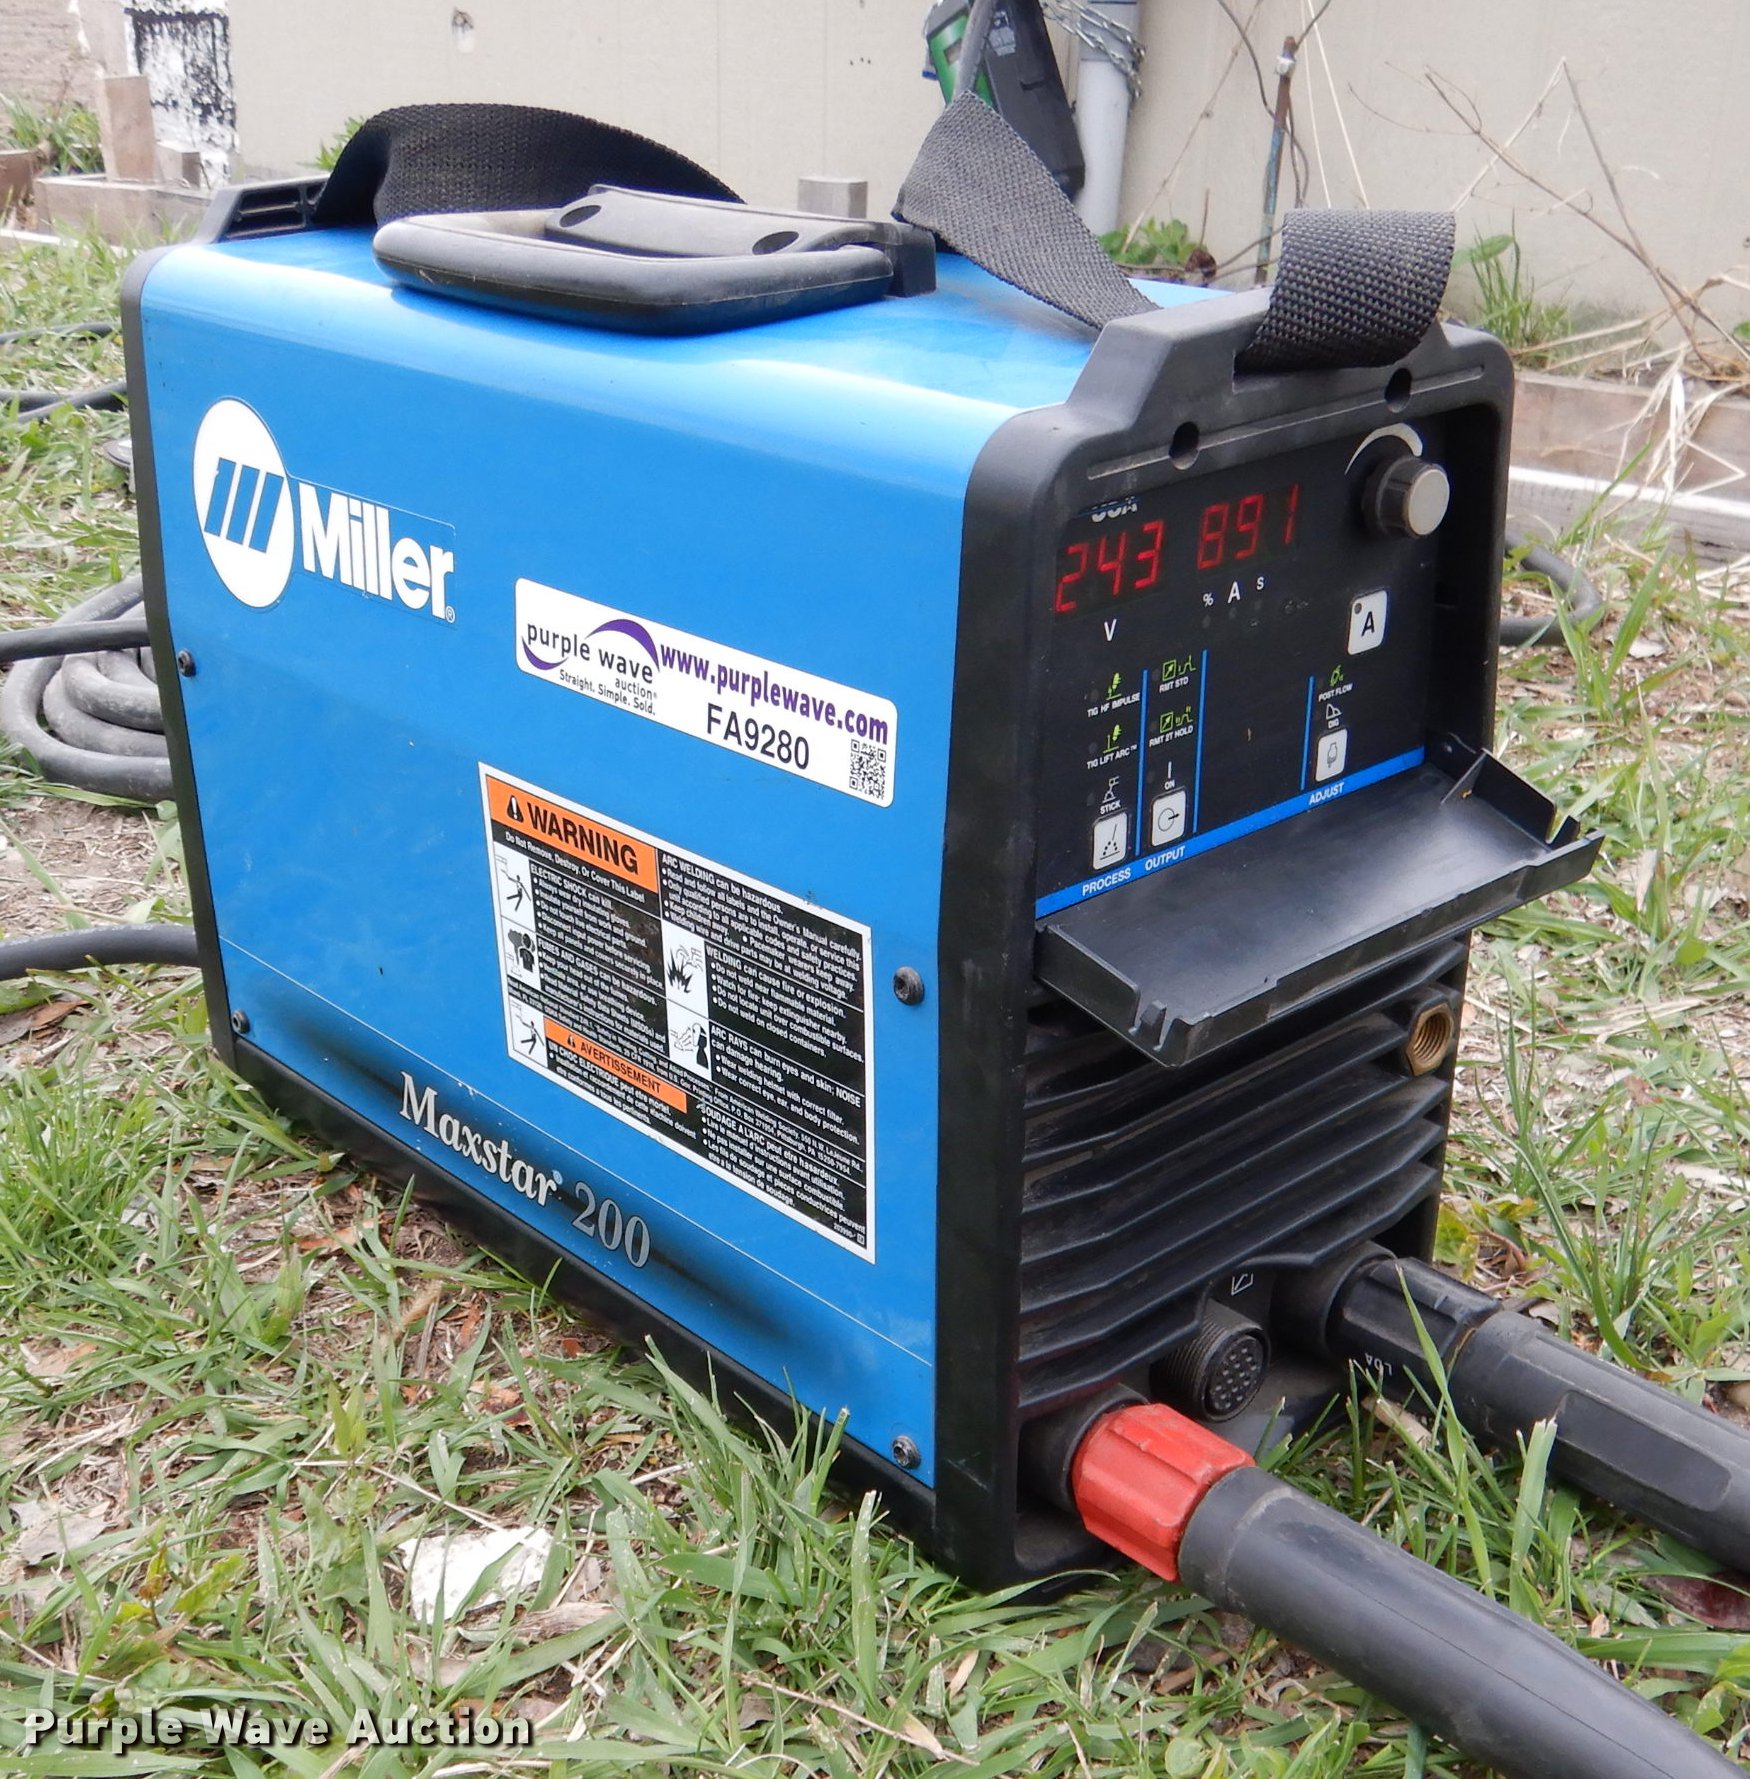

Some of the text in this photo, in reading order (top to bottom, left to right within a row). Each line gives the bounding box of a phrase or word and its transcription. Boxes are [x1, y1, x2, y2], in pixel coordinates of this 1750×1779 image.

[1055, 484, 1300, 613] 243 891
[1228, 581, 1241, 603] A
[1104, 619, 1117, 641] V
[1361, 611, 1375, 636] A
[528, 623, 653, 684] purple wave
[560, 669, 655, 715] Straight. Simple. Sold.
[660, 643, 889, 745] www.purplewave.com
[1175, 676, 1189, 688] STD
[1319, 683, 1353, 701] POST FLOW
[1087, 706, 1099, 717] TIG
[1112, 692, 1140, 709] IMPULSE
[706, 703, 810, 771] FA9280
[1174, 725, 1194, 739] HOLD
[1087, 758, 1099, 769] TIG
[1100, 752, 1114, 765] LIFT
[1164, 779, 1175, 790] ON
[1309, 782, 1345, 805] ADJUST
[1100, 800, 1121, 815] STICK
[527, 802, 637, 874] WARNING
[505, 831, 514, 843] Do
[581, 865, 589, 877] Or
[590, 869, 609, 886] Cover
[611, 878, 624, 893] This
[626, 885, 644, 902] Label
[1145, 845, 1186, 871] OUTPUT
[662, 853, 782, 914] ARC WELDING can be hazardous.
[1082, 868, 1132, 896] PROCESS
[706, 945, 844, 1019] WELDING can cause fire or explosion.
[580, 1041, 660, 1093] AVERTISSEMENT
[711, 1024, 860, 1108] ARC RAYS can burn eyes and skin; NOISE
[712, 1039, 782, 1083] can damage hearing.
[572, 1182, 650, 1268] 200
